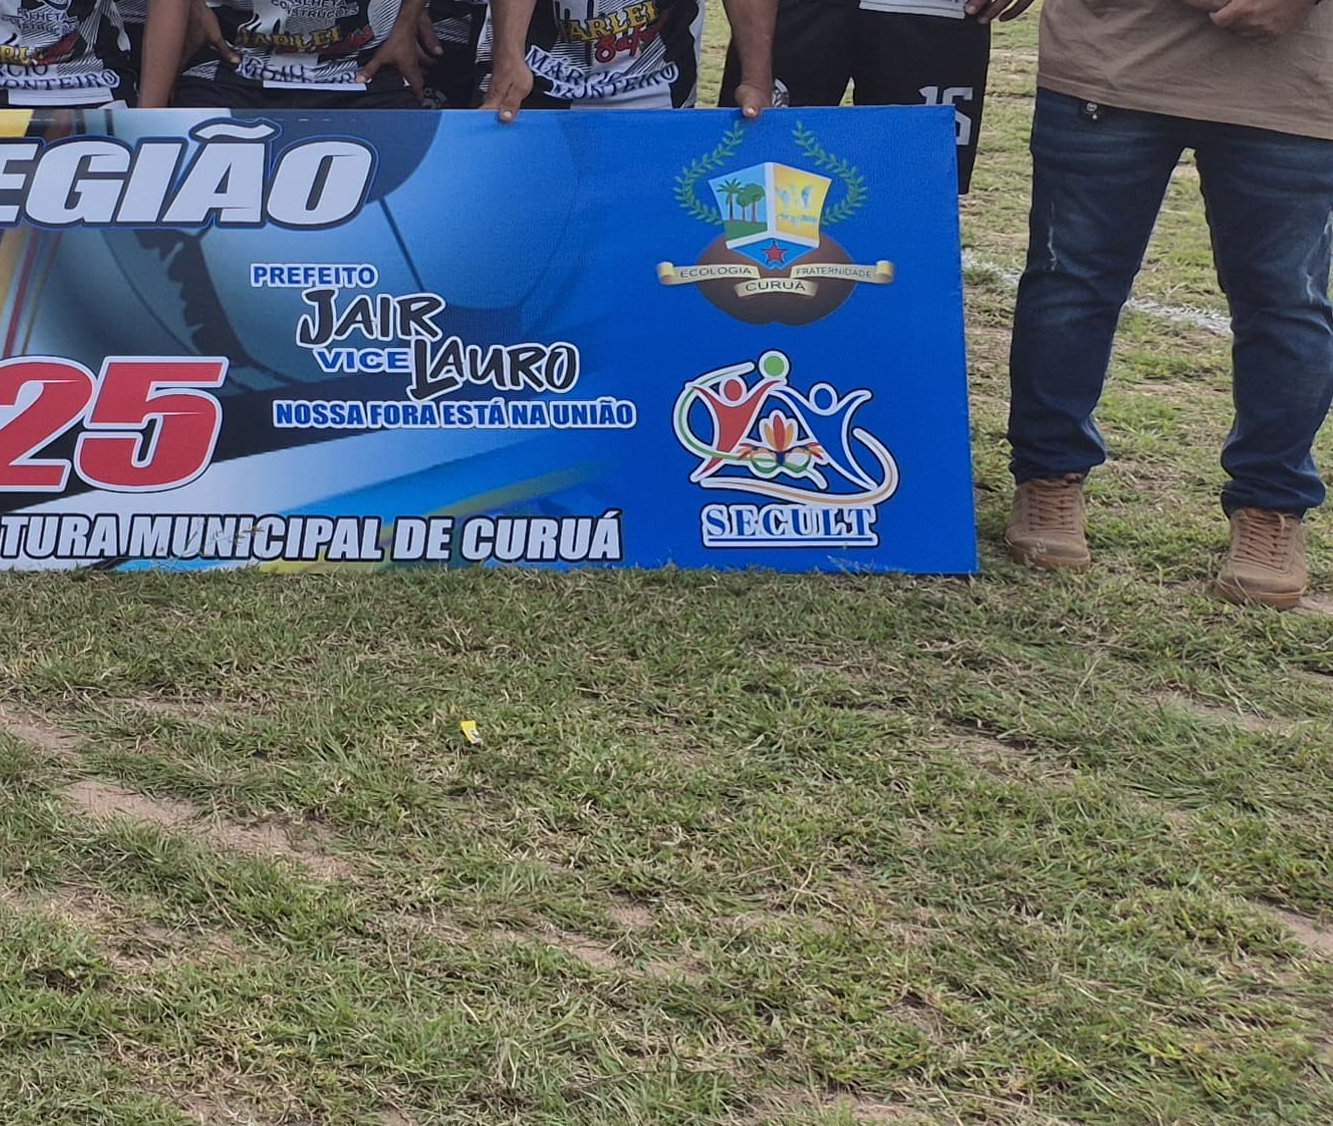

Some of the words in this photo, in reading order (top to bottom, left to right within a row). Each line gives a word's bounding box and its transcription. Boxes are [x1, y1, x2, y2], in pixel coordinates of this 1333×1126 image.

[250, 262, 379, 290] PREFEITO
[680, 265, 752, 279] ECOLOGIA
[796, 268, 872, 279] FRATERNIDADE
[296, 288, 446, 350] JAIR
[314, 346, 410, 375] VICE
[407, 334, 581, 401] LAURO
[273, 400, 368, 429] NOSSA
[369, 400, 441, 429] FORA
[442, 398, 510, 430] ESTÁ
[510, 401, 549, 429] NA
[550, 397, 637, 430] UNIÃO
[130, 514, 385, 562] MUNICIPAL
[391, 516, 452, 561] DE
[459, 509, 623, 562] CURUÁ
[701, 504, 879, 538] SECULT
